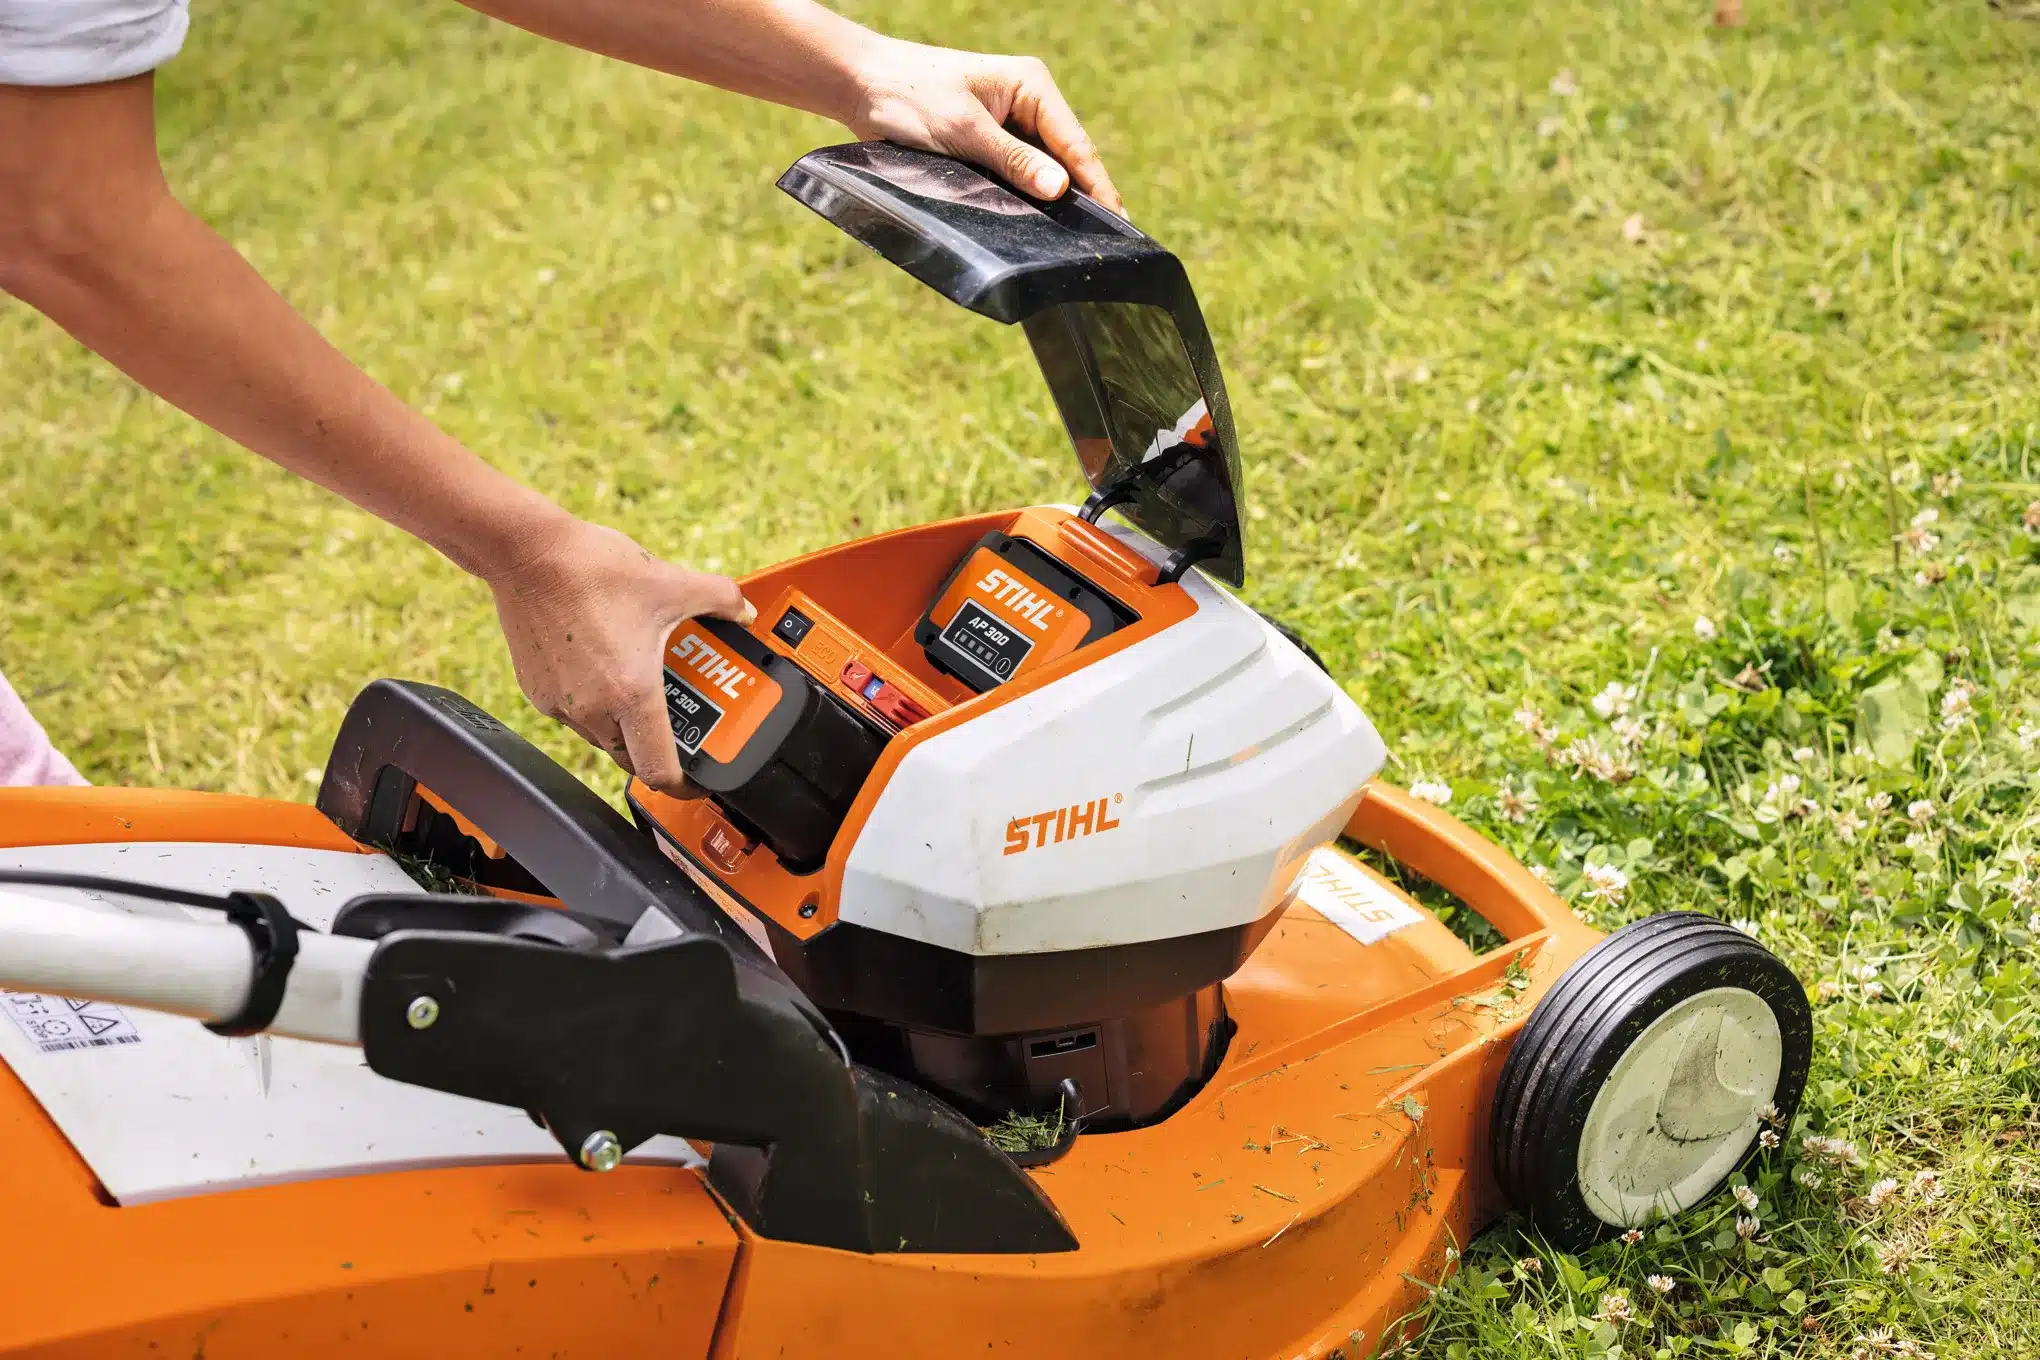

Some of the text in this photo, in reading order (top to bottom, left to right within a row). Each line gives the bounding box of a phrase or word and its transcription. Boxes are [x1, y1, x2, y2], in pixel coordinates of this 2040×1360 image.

[968, 616, 1010, 646] AP 300
[675, 693, 701, 714] 300
